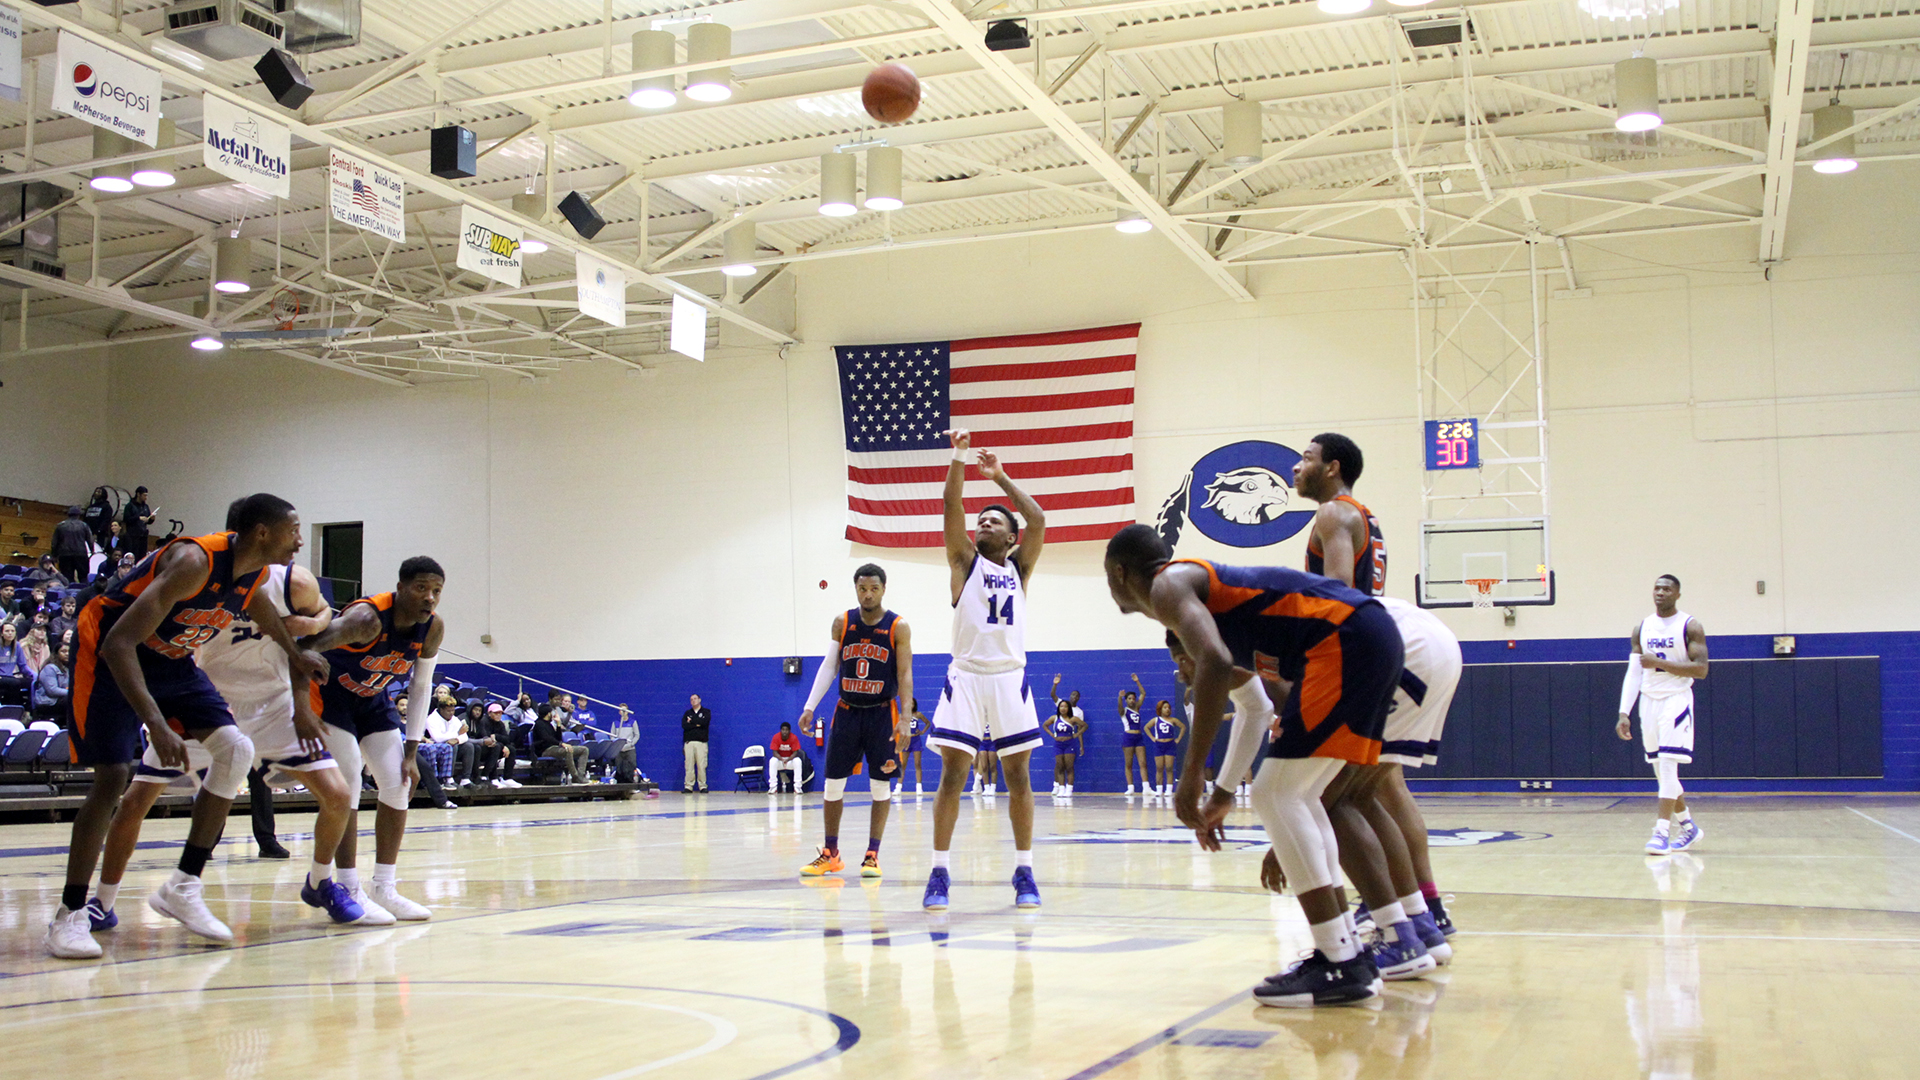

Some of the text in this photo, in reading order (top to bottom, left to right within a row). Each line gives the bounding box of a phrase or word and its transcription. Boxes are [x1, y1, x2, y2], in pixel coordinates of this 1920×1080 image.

[0, 26, 17, 39] ISIS
[100, 81, 150, 112] pepsi
[73, 100, 146, 137] McPherson Beverage
[207, 128, 286, 175] Metal Tech
[219, 154, 231, 166] Of
[332, 154, 364, 177] Central Ford
[374, 171, 401, 193] Quick Lane
[332, 205, 346, 220] THE
[347, 212, 386, 234] AMERICAN
[387, 227, 401, 239] WAY
[465, 223, 520, 259] SUBWAY
[480, 258, 519, 267] eat fresh
[1437, 422, 1473, 439] 2:26
[1436, 438, 1468, 466] 30
[983, 574, 1016, 590] HAWKS
[987, 594, 1013, 625] 14
[170, 626, 214, 650] 22
[1647, 637, 1674, 648] HAWKS
[843, 643, 889, 664] LINCOLN
[856, 658, 869, 679] 0
[361, 673, 394, 689] 11
